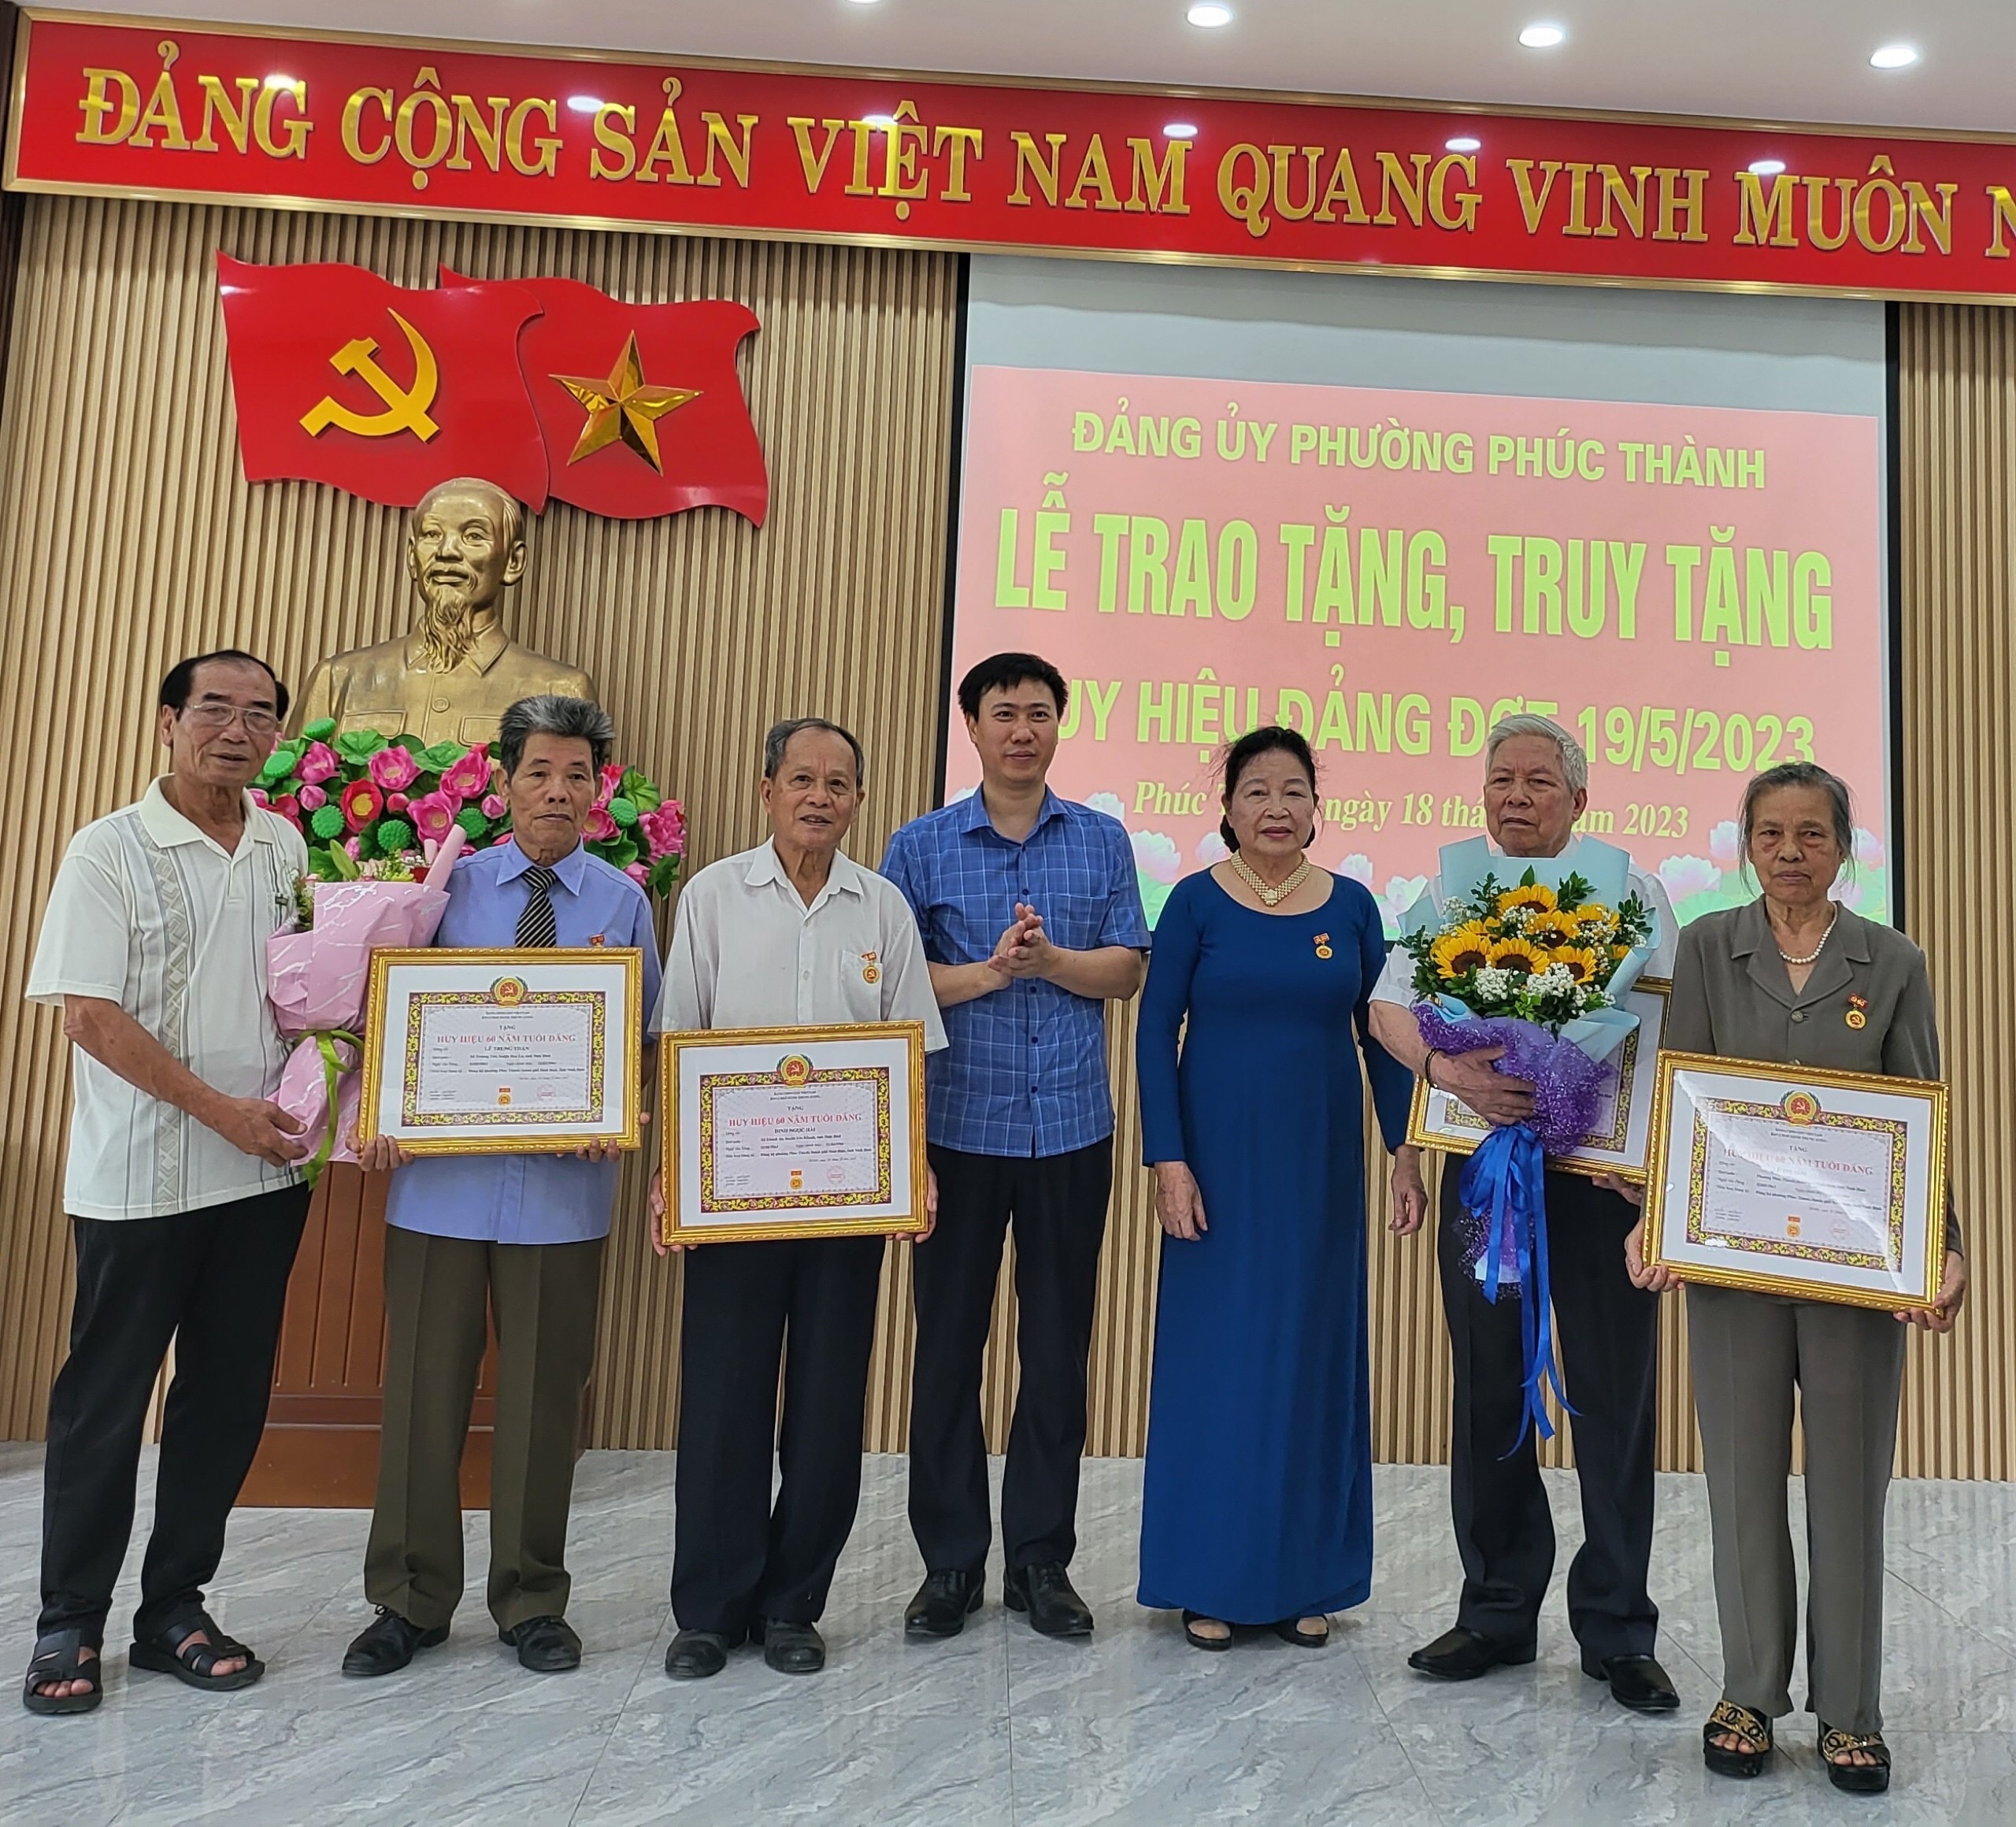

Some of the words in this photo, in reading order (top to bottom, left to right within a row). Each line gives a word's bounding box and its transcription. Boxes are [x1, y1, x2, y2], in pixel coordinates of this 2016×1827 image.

[76, 40, 313, 160] ĐẢNG
[341, 66, 563, 190] CỘNG
[591, 77, 759, 187] SẢN
[788, 101, 983, 220] VIỆT
[1007, 131, 1193, 214] NAM
[1217, 143, 1482, 237] QUANG
[1506, 158, 1710, 243] VINH
[1733, 155, 1958, 256] MUÔN
[1073, 397, 1202, 458] ĐẢNG
[1217, 402, 1278, 461] ỦY
[1291, 417, 1473, 474] PHƯỜNG
[1489, 428, 1605, 481] PHÚC
[1618, 435, 1766, 489] THÀNH
[995, 472, 1070, 611] LỄ
[1094, 513, 1258, 621] TRAO
[1280, 504, 1466, 647] TẶNG,
[1488, 535, 1647, 639] TRUY
[1666, 526, 1833, 666] TẶNG
[1058, 680, 1122, 740] UY
[1137, 668, 1258, 763] HIỆU
[1276, 664, 1431, 755] ĐẢNG
[1578, 706, 1814, 775] 19/5/2023
[1132, 781, 1207, 816] Phúc
[1324, 791, 1392, 832] ngày
[1400, 792, 1434, 826] 18
[1441, 795, 1487, 828] thá
[1622, 803, 1688, 838] 2023
